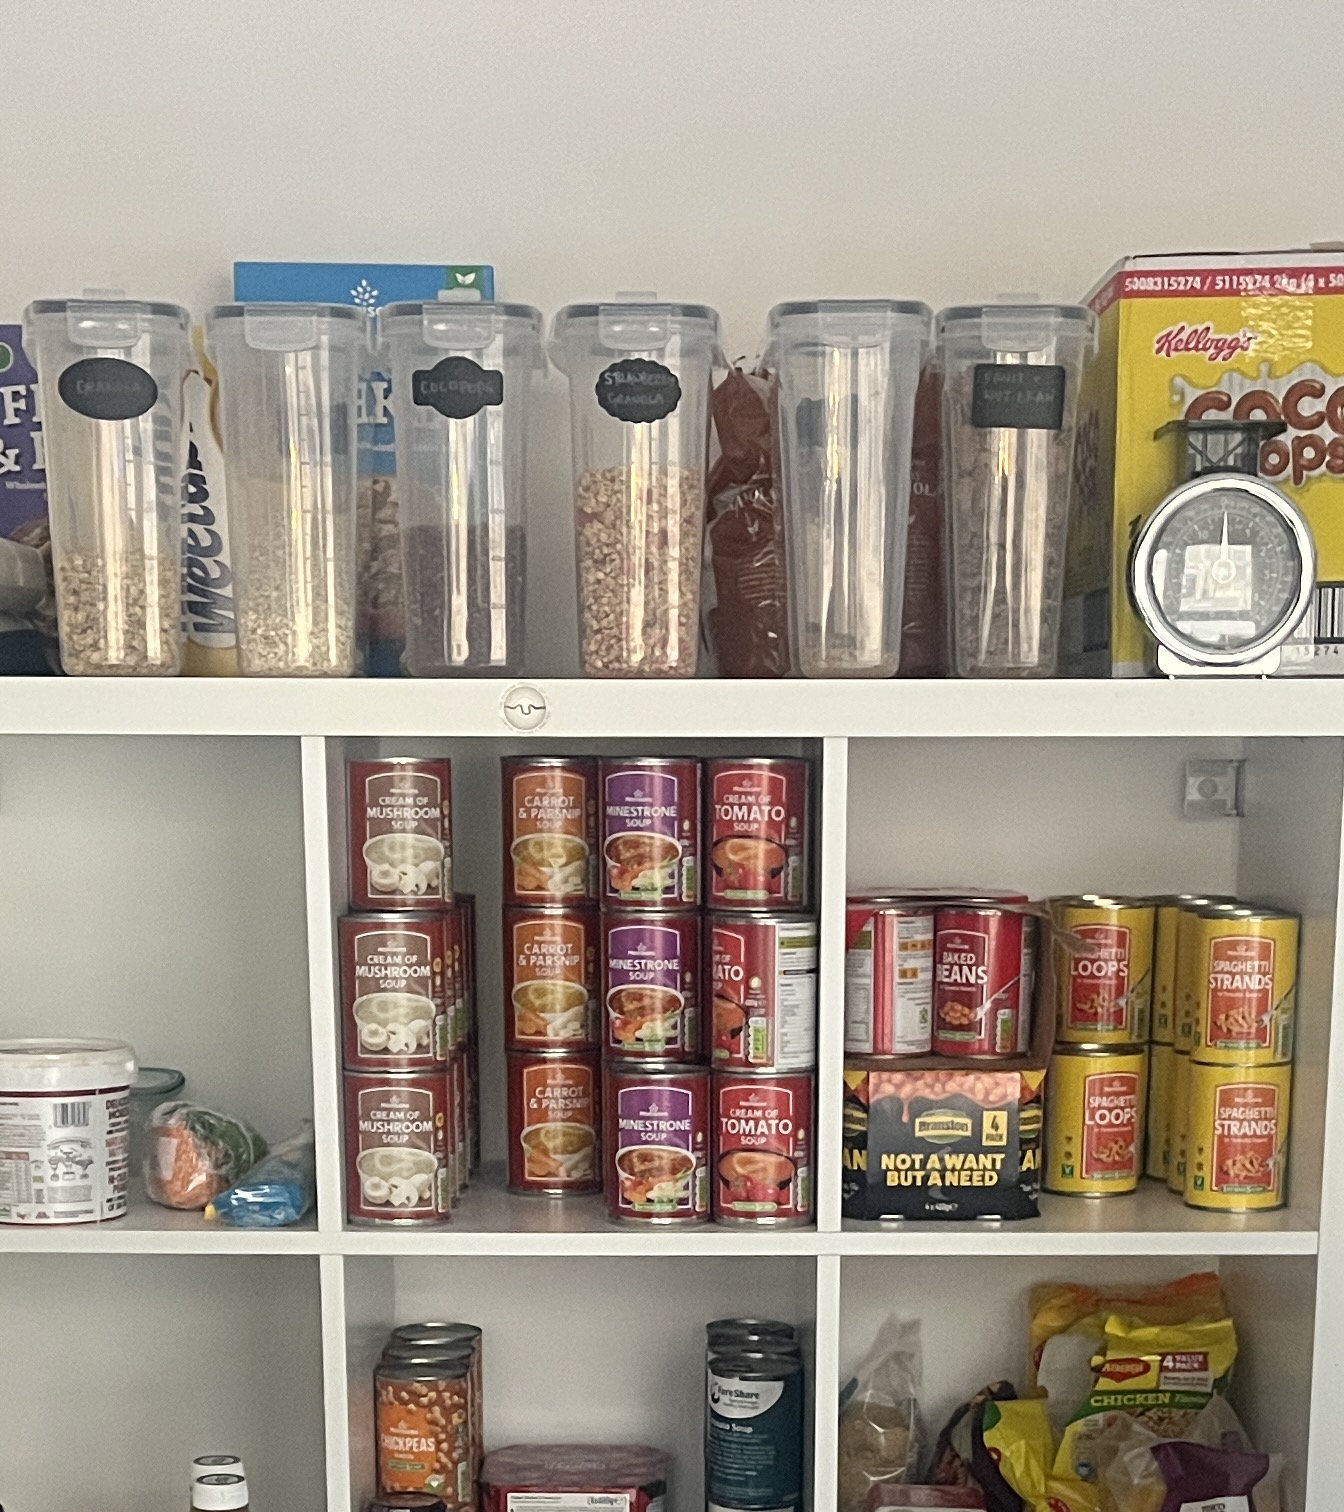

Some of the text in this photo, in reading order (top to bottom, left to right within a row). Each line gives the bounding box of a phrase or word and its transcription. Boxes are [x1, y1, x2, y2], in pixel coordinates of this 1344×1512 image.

[378, 797, 429, 805] CREAM OF
[525, 796, 574, 808] CARROT
[367, 807, 440, 819] MUSHROOM
[606, 806, 677, 818] MINESTRONE
[714, 804, 785, 821] TOMATO
[392, 820, 418, 830] SOUP
[625, 818, 653, 828] SOUP
[733, 821, 759, 832] SOUP
[524, 943, 573, 955] CARROT
[367, 955, 418, 963] CREAM OF
[530, 955, 580, 967] PARSNIP
[942, 952, 976, 965] BAKED
[355, 965, 431, 977] MUSHROOM
[609, 959, 679, 971] MINESTRONE
[1071, 960, 1128, 977] LOOPS
[1213, 960, 1269, 973] SPAGHETTI
[628, 970, 655, 980] SOUP
[936, 965, 988, 984] BEANS
[379, 979, 407, 989] SOUP
[1208, 973, 1273, 989] STRANDS
[535, 1086, 585, 1099] CARROT
[370, 1111, 421, 1120] CREAM OF
[547, 1110, 573, 1120] SOUP
[729, 1108, 779, 1118] CREAM OF
[1085, 1109, 1137, 1126] LOOPS
[1220, 1106, 1274, 1120] SPAGHETTI
[359, 1120, 433, 1133] MUSHROOM
[619, 1118, 690, 1131] MINESTRONE
[721, 1118, 792, 1135] TOMATO
[990, 1114, 1000, 1132] 4
[1215, 1120, 1277, 1136] STRANDS
[382, 1134, 409, 1144] SOUP
[640, 1131, 668, 1142] SOUP
[740, 1135, 767, 1145] SOUP
[880, 1153, 1006, 1170] NOT A WANT
[886, 1170, 999, 1187] BUT A NEED
[1162, 1355, 1174, 1369] 4
[1090, 1393, 1171, 1407] CHICKEN
